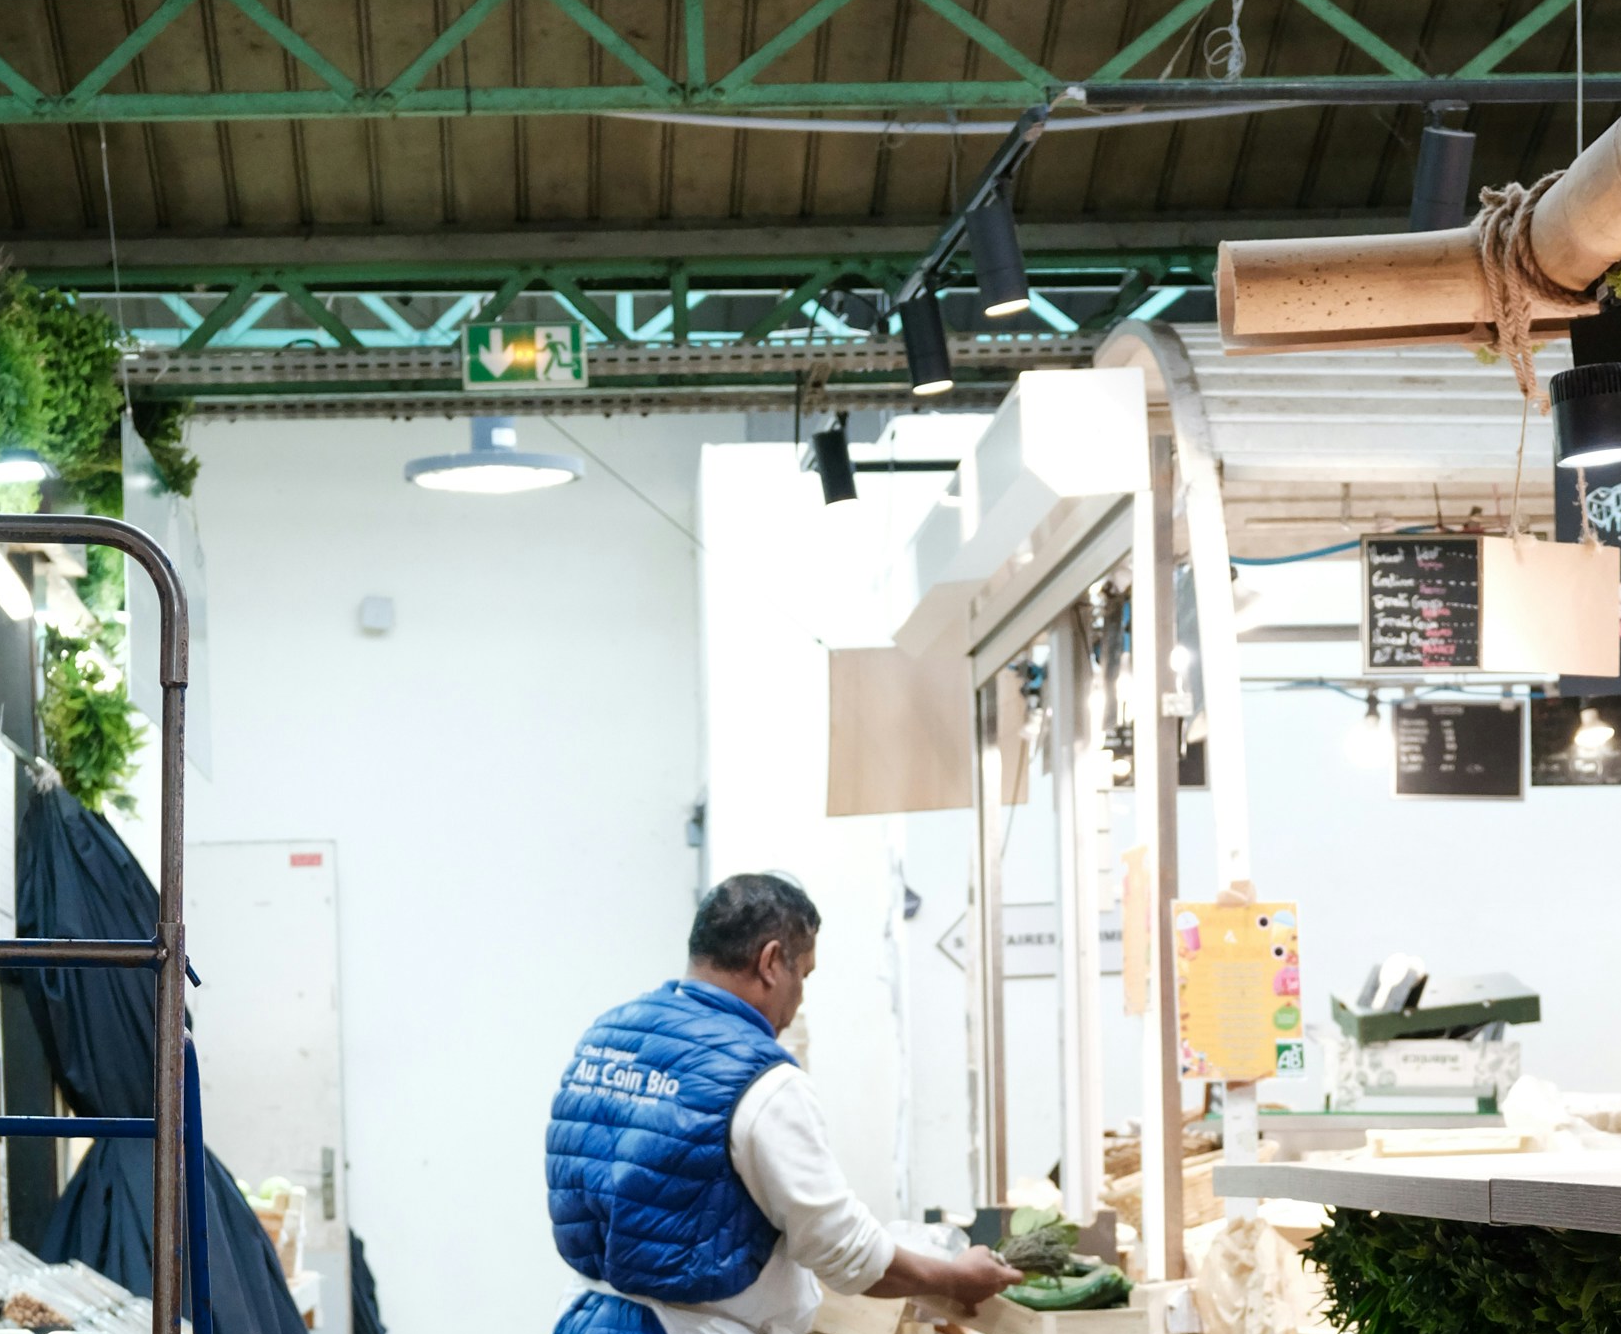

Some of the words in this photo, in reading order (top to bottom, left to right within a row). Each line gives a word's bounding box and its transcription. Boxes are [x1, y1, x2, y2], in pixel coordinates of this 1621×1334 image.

[572, 1057, 600, 1082] Au
[602, 1061, 641, 1090] Coin
[646, 1068, 681, 1097] Bio
